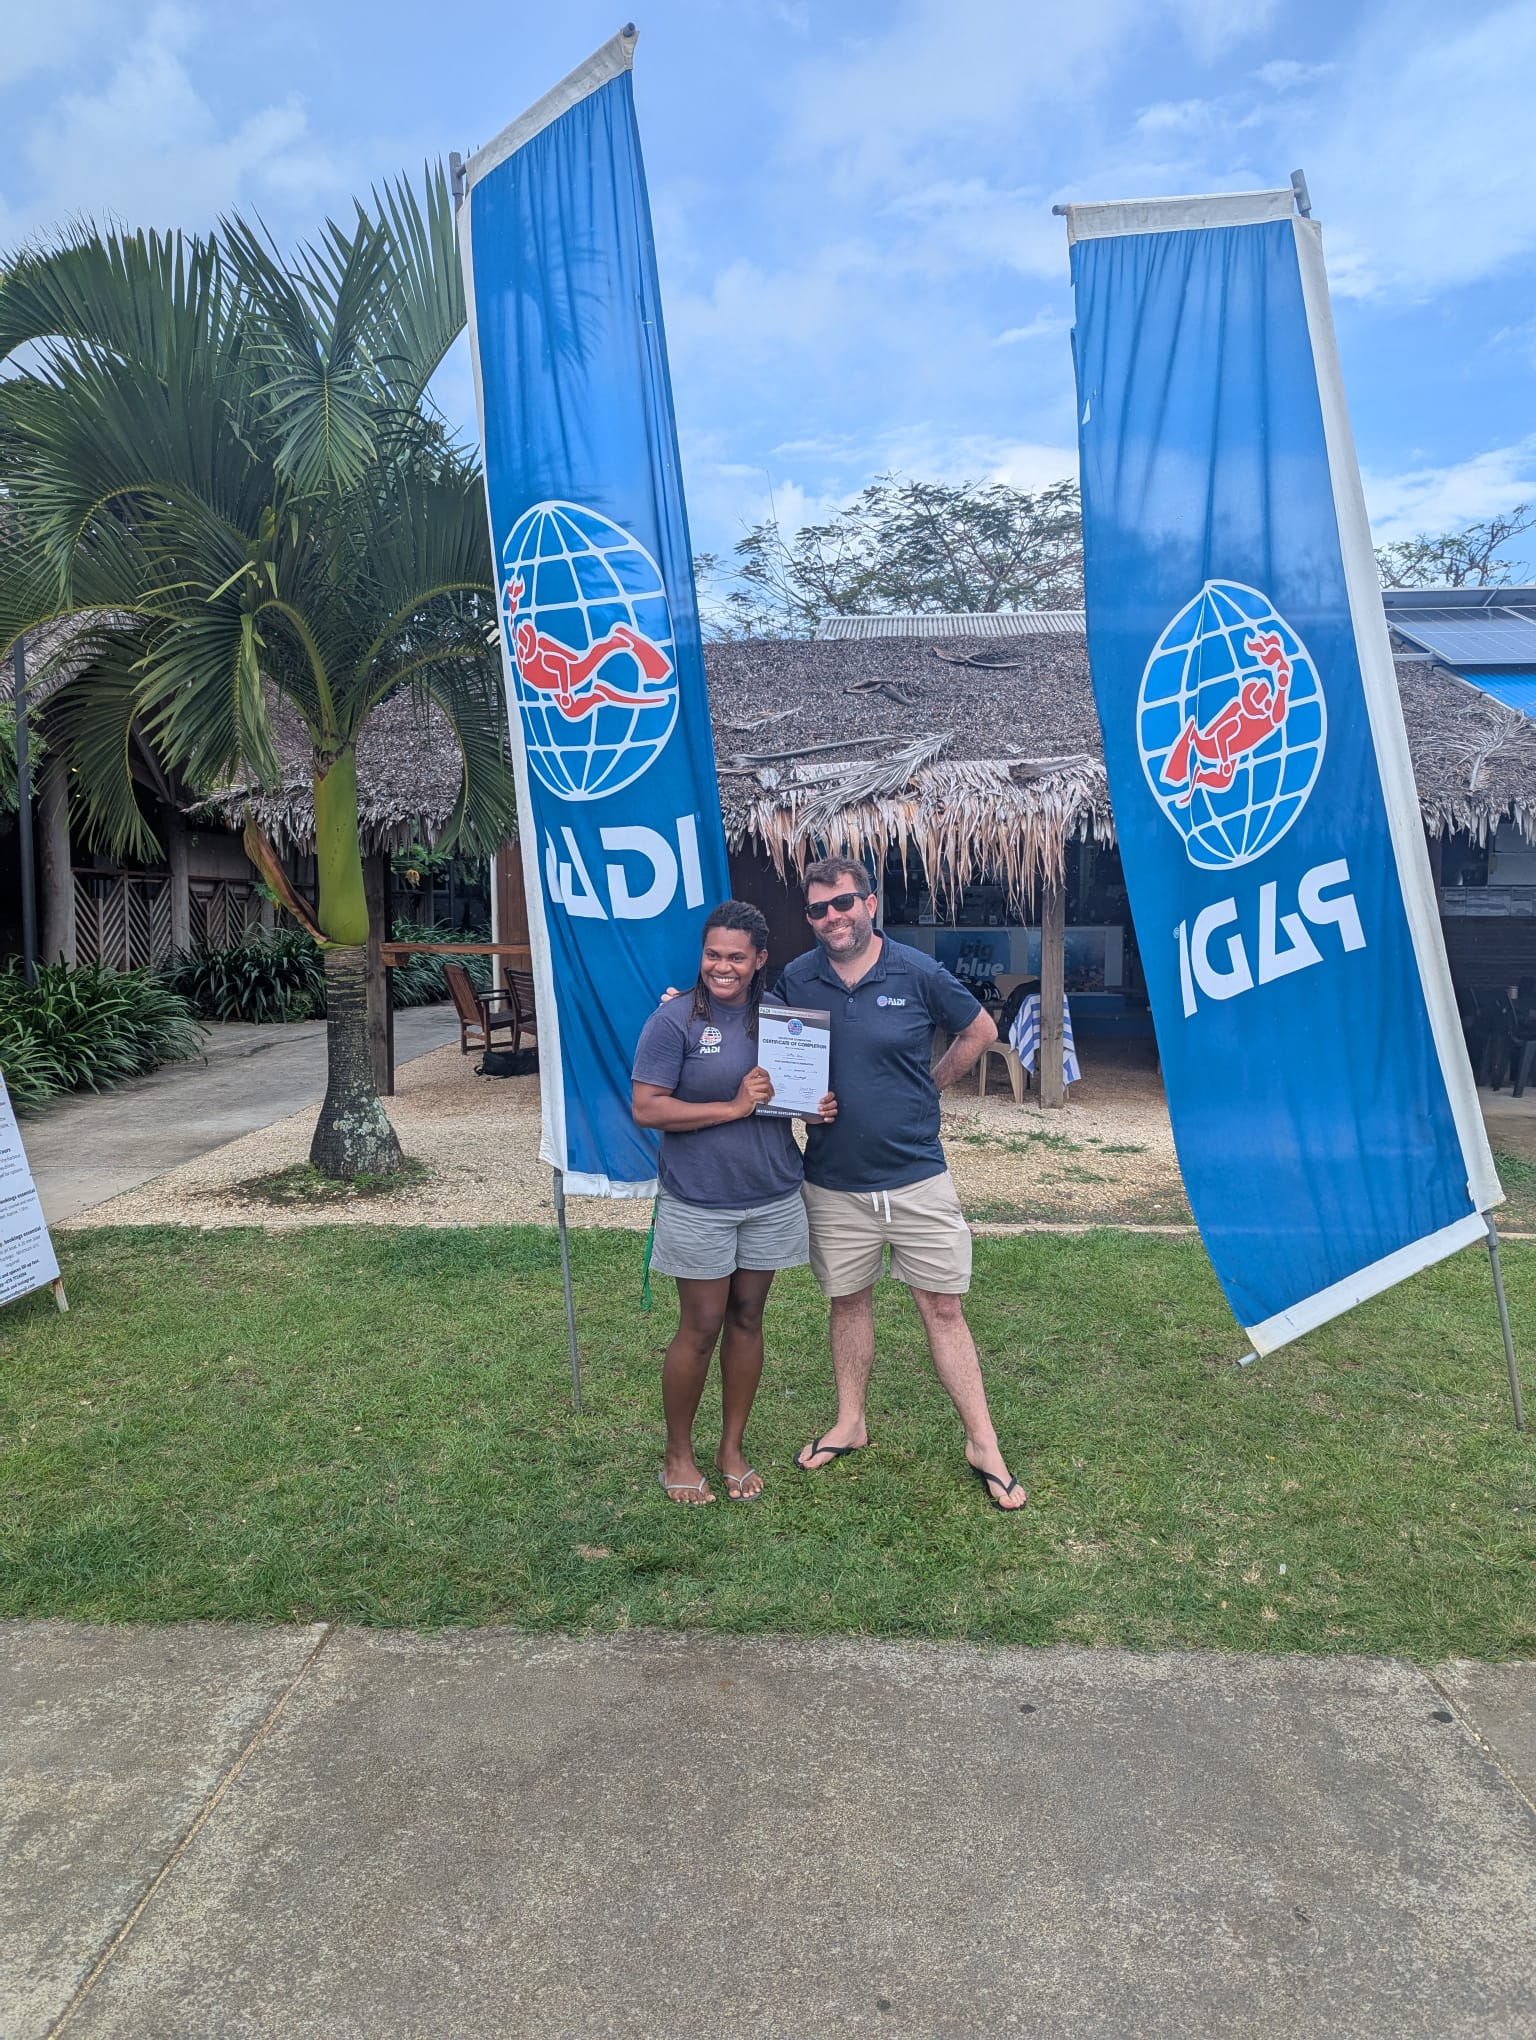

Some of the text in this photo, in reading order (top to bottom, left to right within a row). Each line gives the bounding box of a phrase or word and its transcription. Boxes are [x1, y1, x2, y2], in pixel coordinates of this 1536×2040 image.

[959, 938, 995, 960] big
[955, 957, 1005, 977] blue
[887, 997, 905, 1006] PADI
[699, 1045, 720, 1055] PADI
